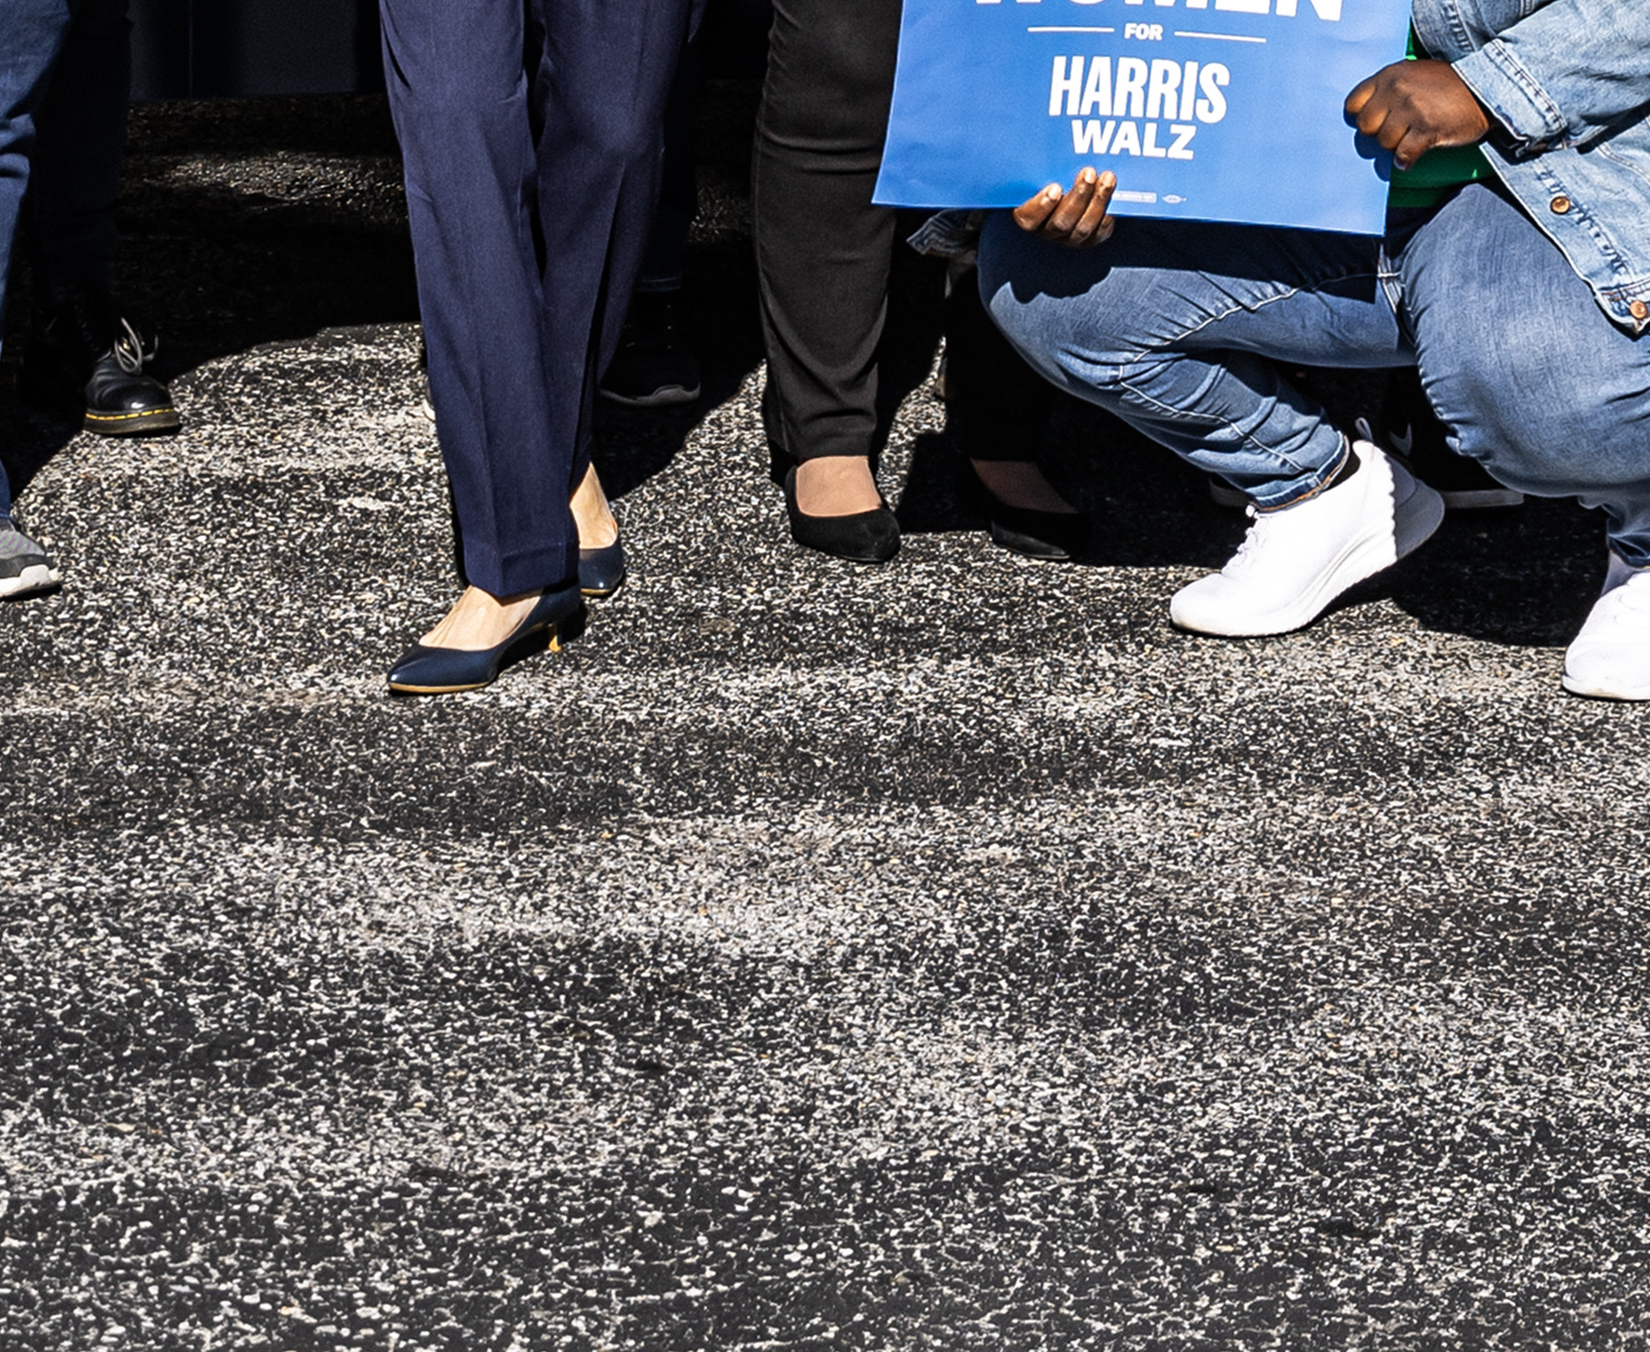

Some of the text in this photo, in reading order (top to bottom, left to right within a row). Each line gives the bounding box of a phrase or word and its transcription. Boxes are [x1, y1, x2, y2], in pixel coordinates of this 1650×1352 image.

[1123, 22, 1164, 41] FOR
[1048, 55, 1230, 123] HARRIS
[1071, 118, 1198, 161] WALZ
